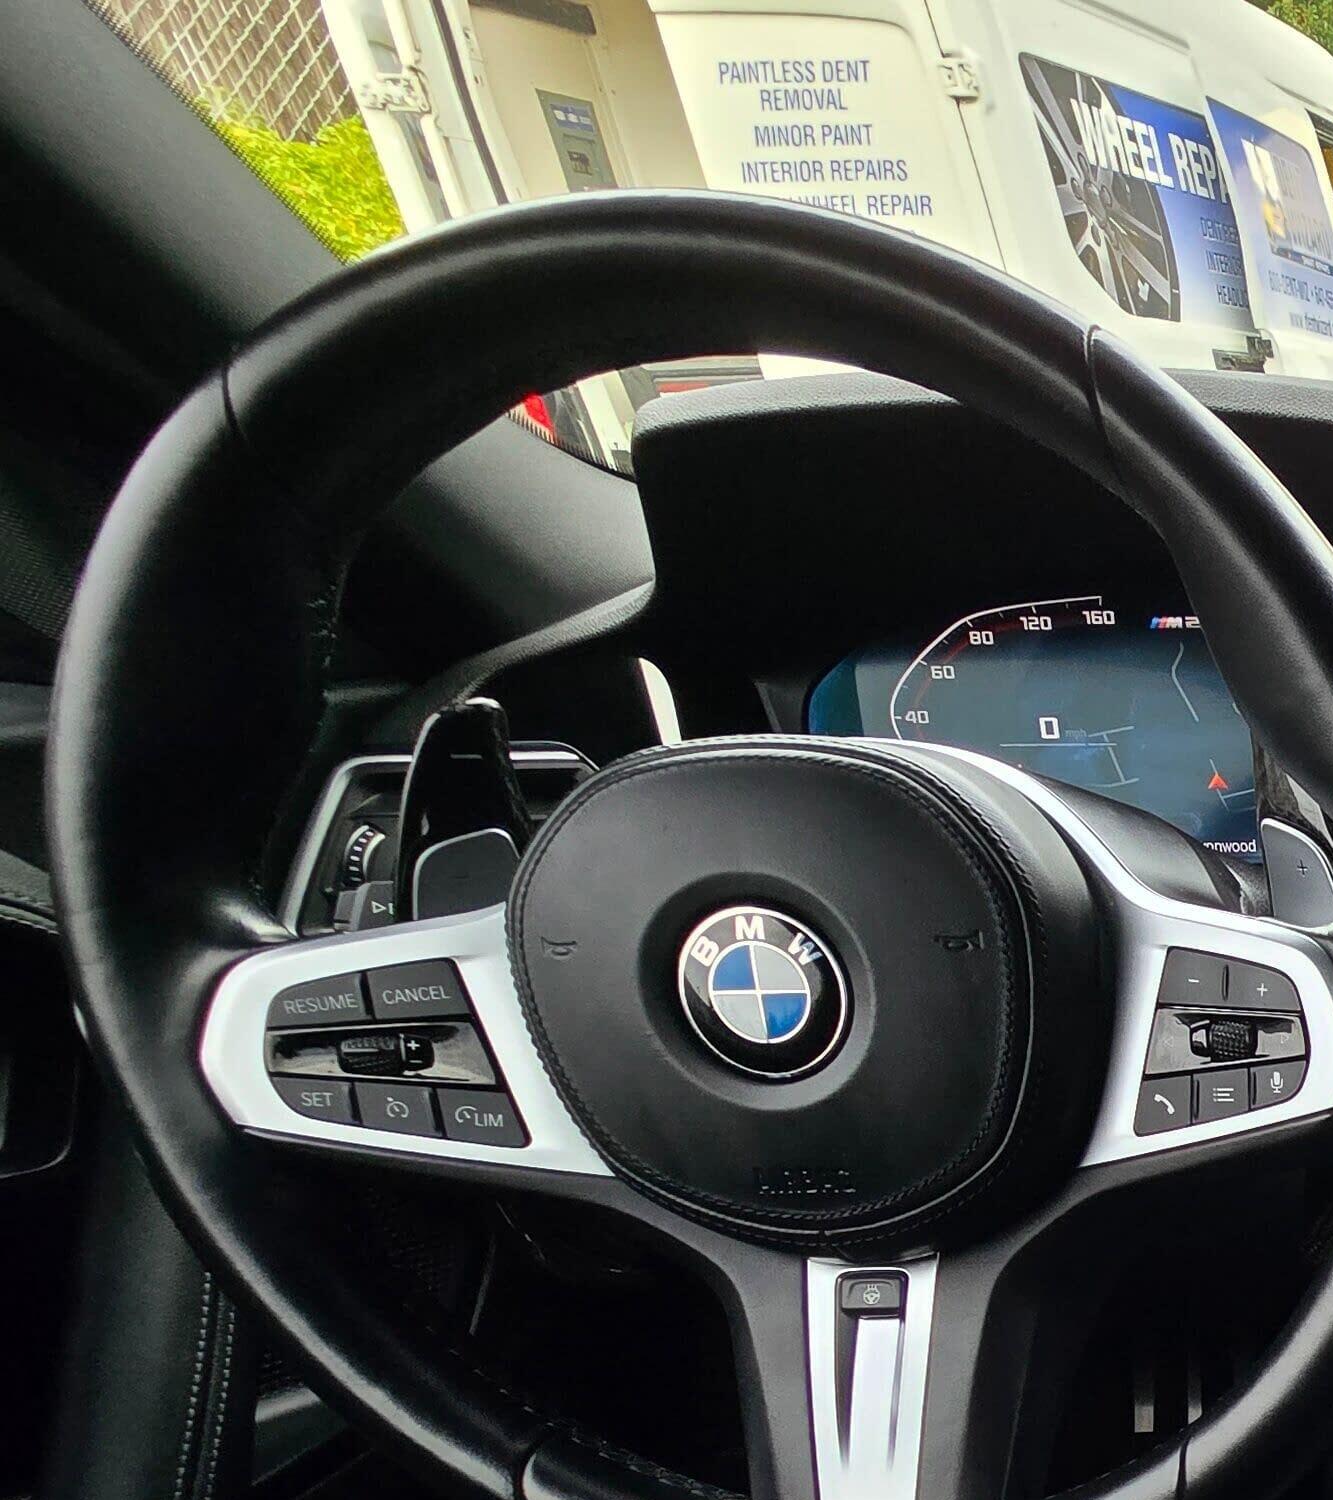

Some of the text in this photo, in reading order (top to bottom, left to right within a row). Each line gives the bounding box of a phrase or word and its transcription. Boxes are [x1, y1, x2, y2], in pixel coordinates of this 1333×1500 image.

[718, 60, 870, 84] PAINTLESS DENT
[760, 88, 848, 111] REMOVAL
[754, 124, 873, 147] MINOR PAINT
[1069, 98, 1174, 189] WHEEL
[741, 159, 908, 184] INTERIOR REPAIRS
[867, 195, 933, 216] REPAIR
[1019, 616, 1052, 631] 120
[1082, 610, 1116, 625] 160
[969, 630, 994, 645] 80
[931, 665, 955, 679] 60
[905, 710, 930, 724] 40
[1039, 717, 1061, 739] 0
[690, 915, 823, 967] BMW
[284, 993, 358, 1015] RESUME
[382, 985, 450, 1005] CANCEL
[301, 1092, 333, 1107] SET
[475, 1112, 504, 1128] LIM
